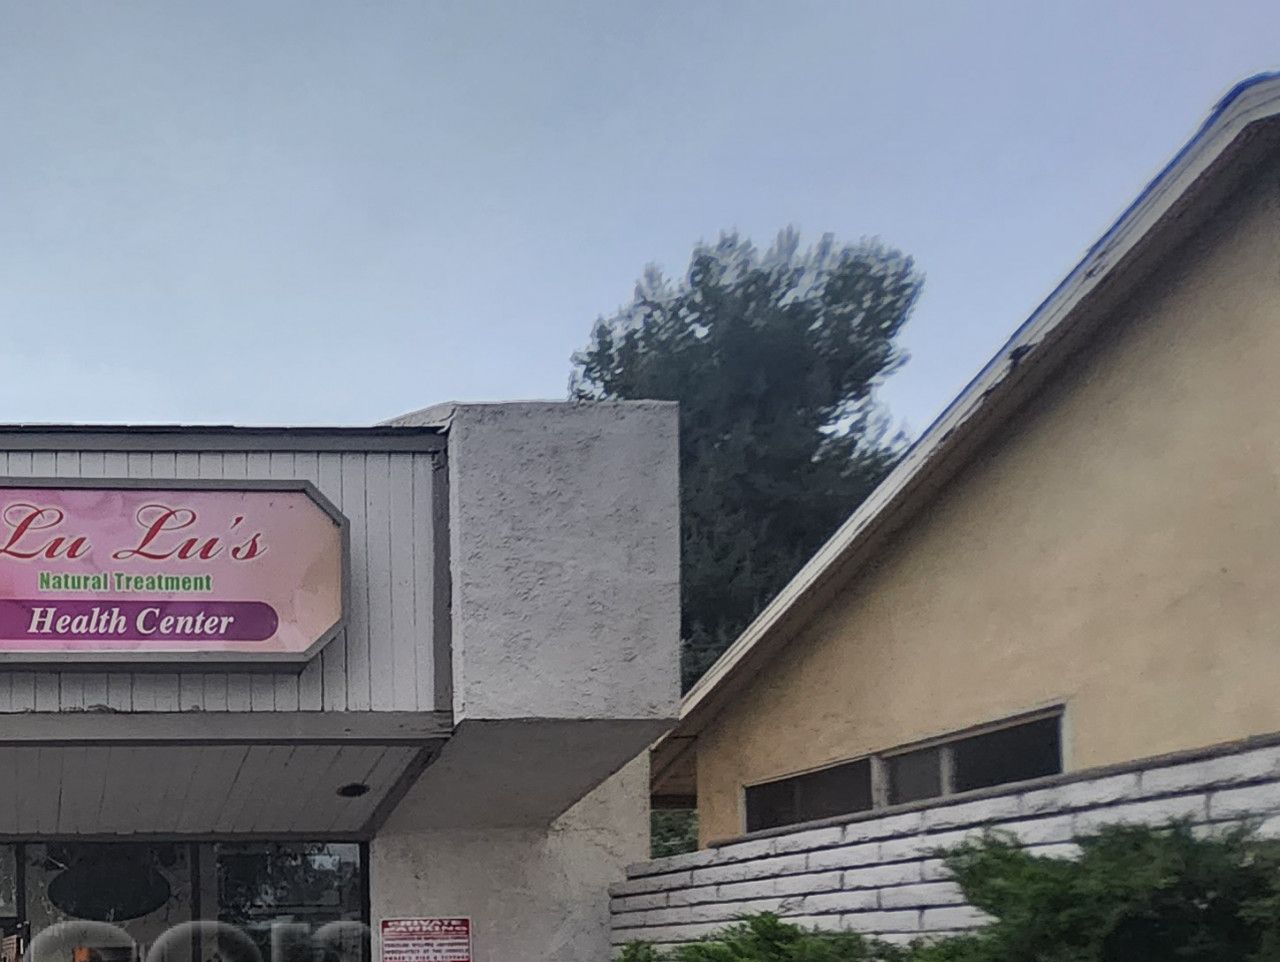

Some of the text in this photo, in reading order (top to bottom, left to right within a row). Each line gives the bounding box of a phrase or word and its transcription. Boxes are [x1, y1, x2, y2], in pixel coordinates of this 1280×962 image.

[113, 503, 268, 561] Lu's
[39, 570, 213, 593] Natural Treatment
[27, 606, 234, 637] Health Center
